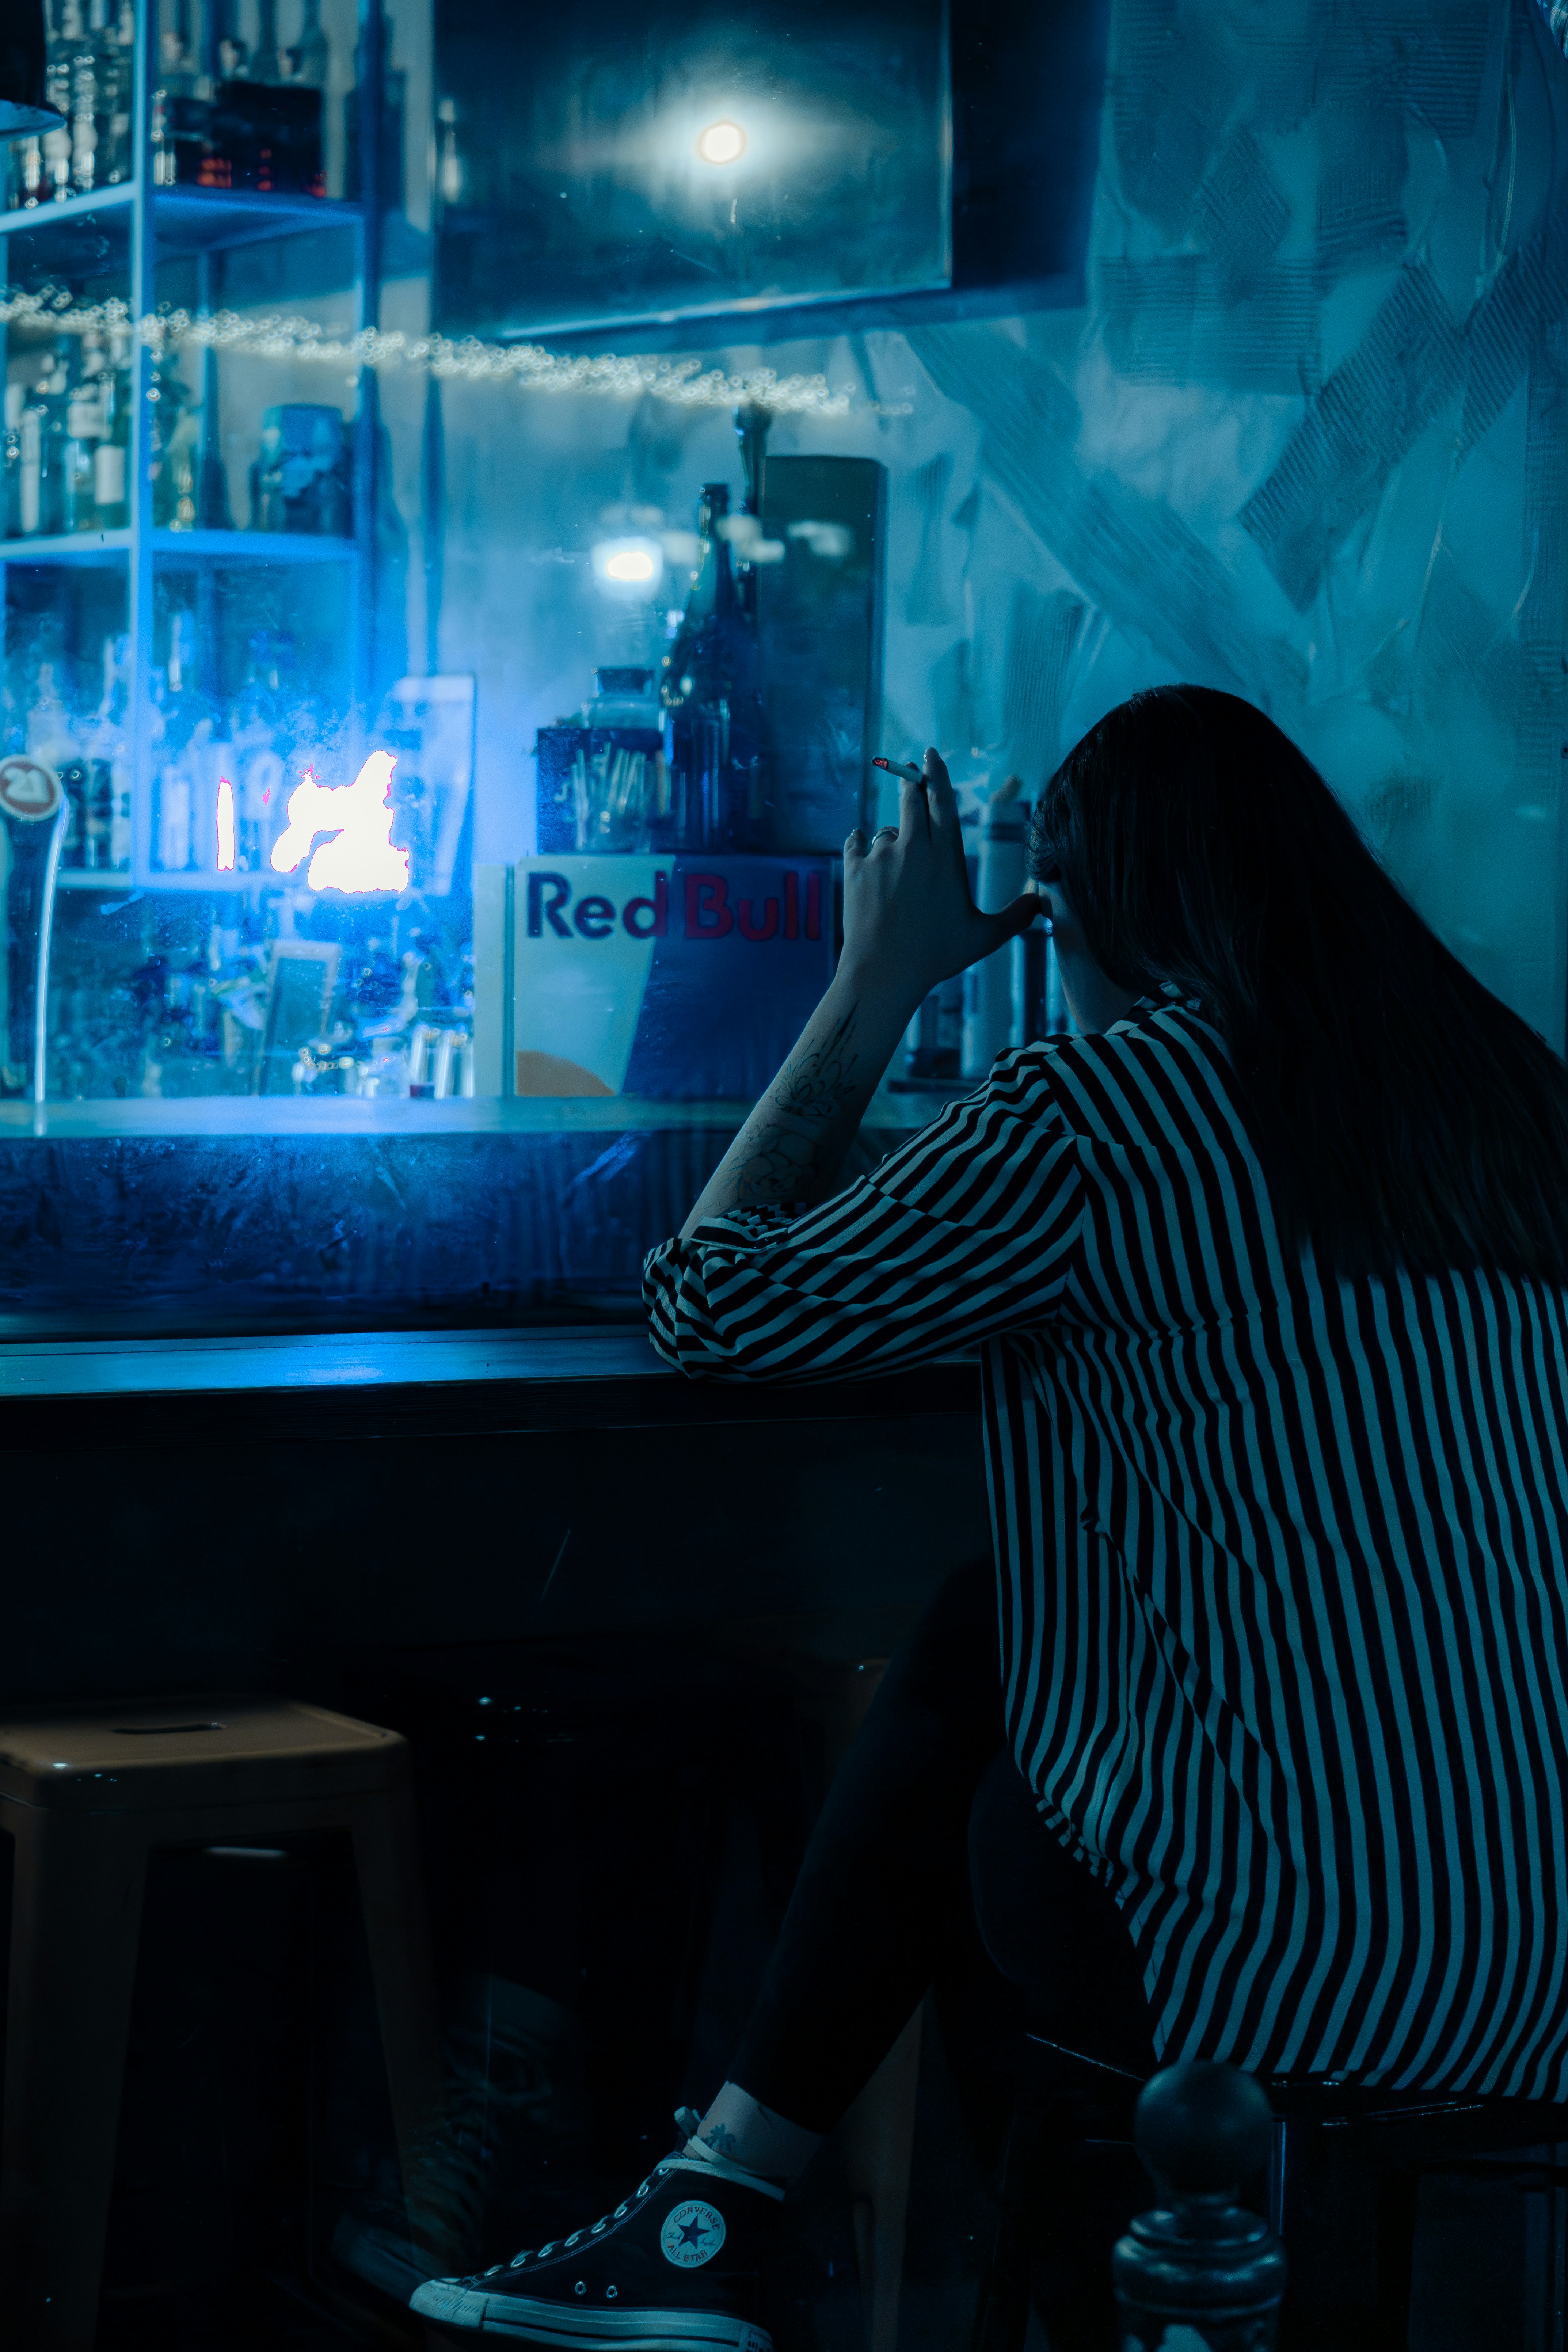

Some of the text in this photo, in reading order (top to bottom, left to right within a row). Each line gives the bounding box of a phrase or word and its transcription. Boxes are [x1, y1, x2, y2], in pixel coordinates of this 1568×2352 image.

[526, 871, 821, 941] Red Bull
[673, 2206, 720, 2230] CONVERSE
[667, 2244, 708, 2263] ALL STAR
